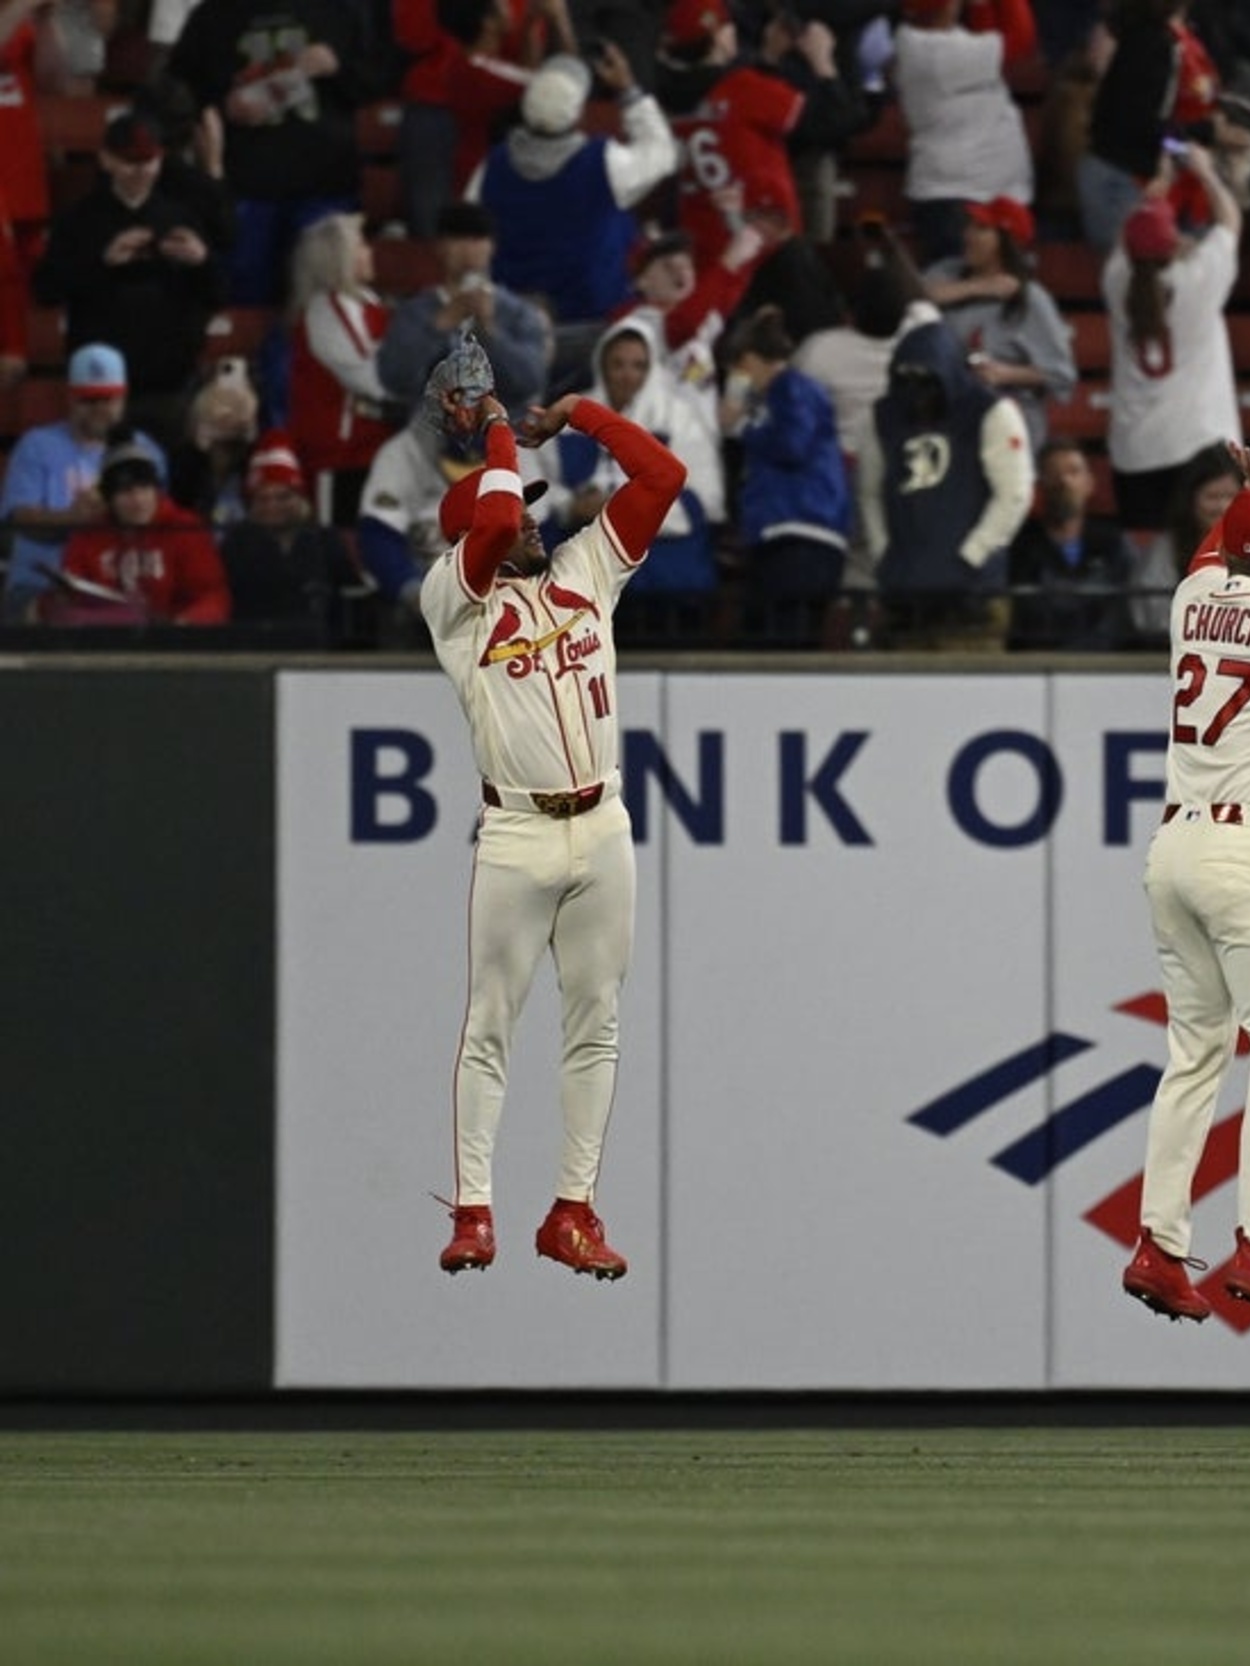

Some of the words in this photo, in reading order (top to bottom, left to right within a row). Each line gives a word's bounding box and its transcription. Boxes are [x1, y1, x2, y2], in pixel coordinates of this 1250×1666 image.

[677, 128, 731, 191] 6
[555, 626, 602, 681] Louis
[588, 673, 610, 720] 11
[349, 728, 876, 846] BNK
[947, 730, 1168, 849] OF
